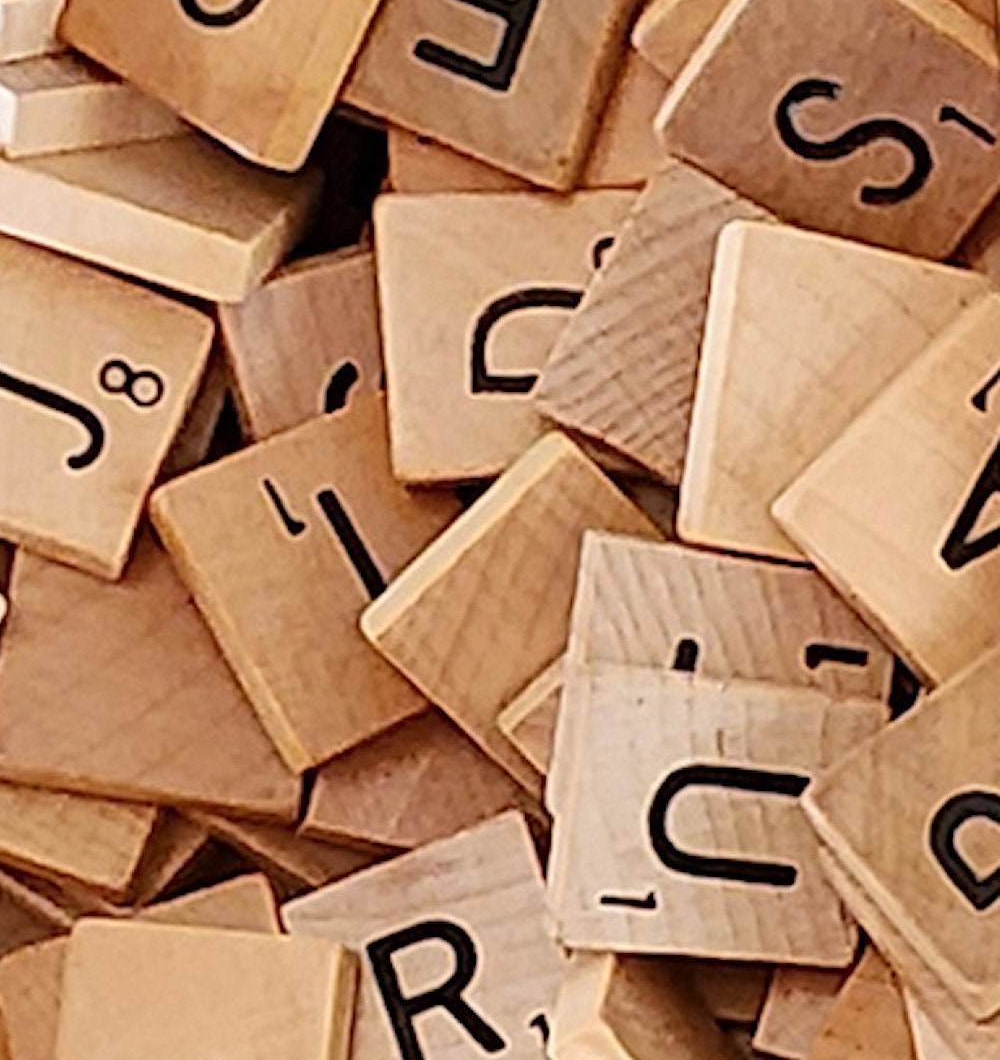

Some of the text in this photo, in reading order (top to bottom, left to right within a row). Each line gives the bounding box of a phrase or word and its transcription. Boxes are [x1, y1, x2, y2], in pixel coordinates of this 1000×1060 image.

[775, 79, 934, 206] S
[99, 360, 164, 407] 8
[648, 764, 812, 888] U
[366, 920, 506, 1060] R
